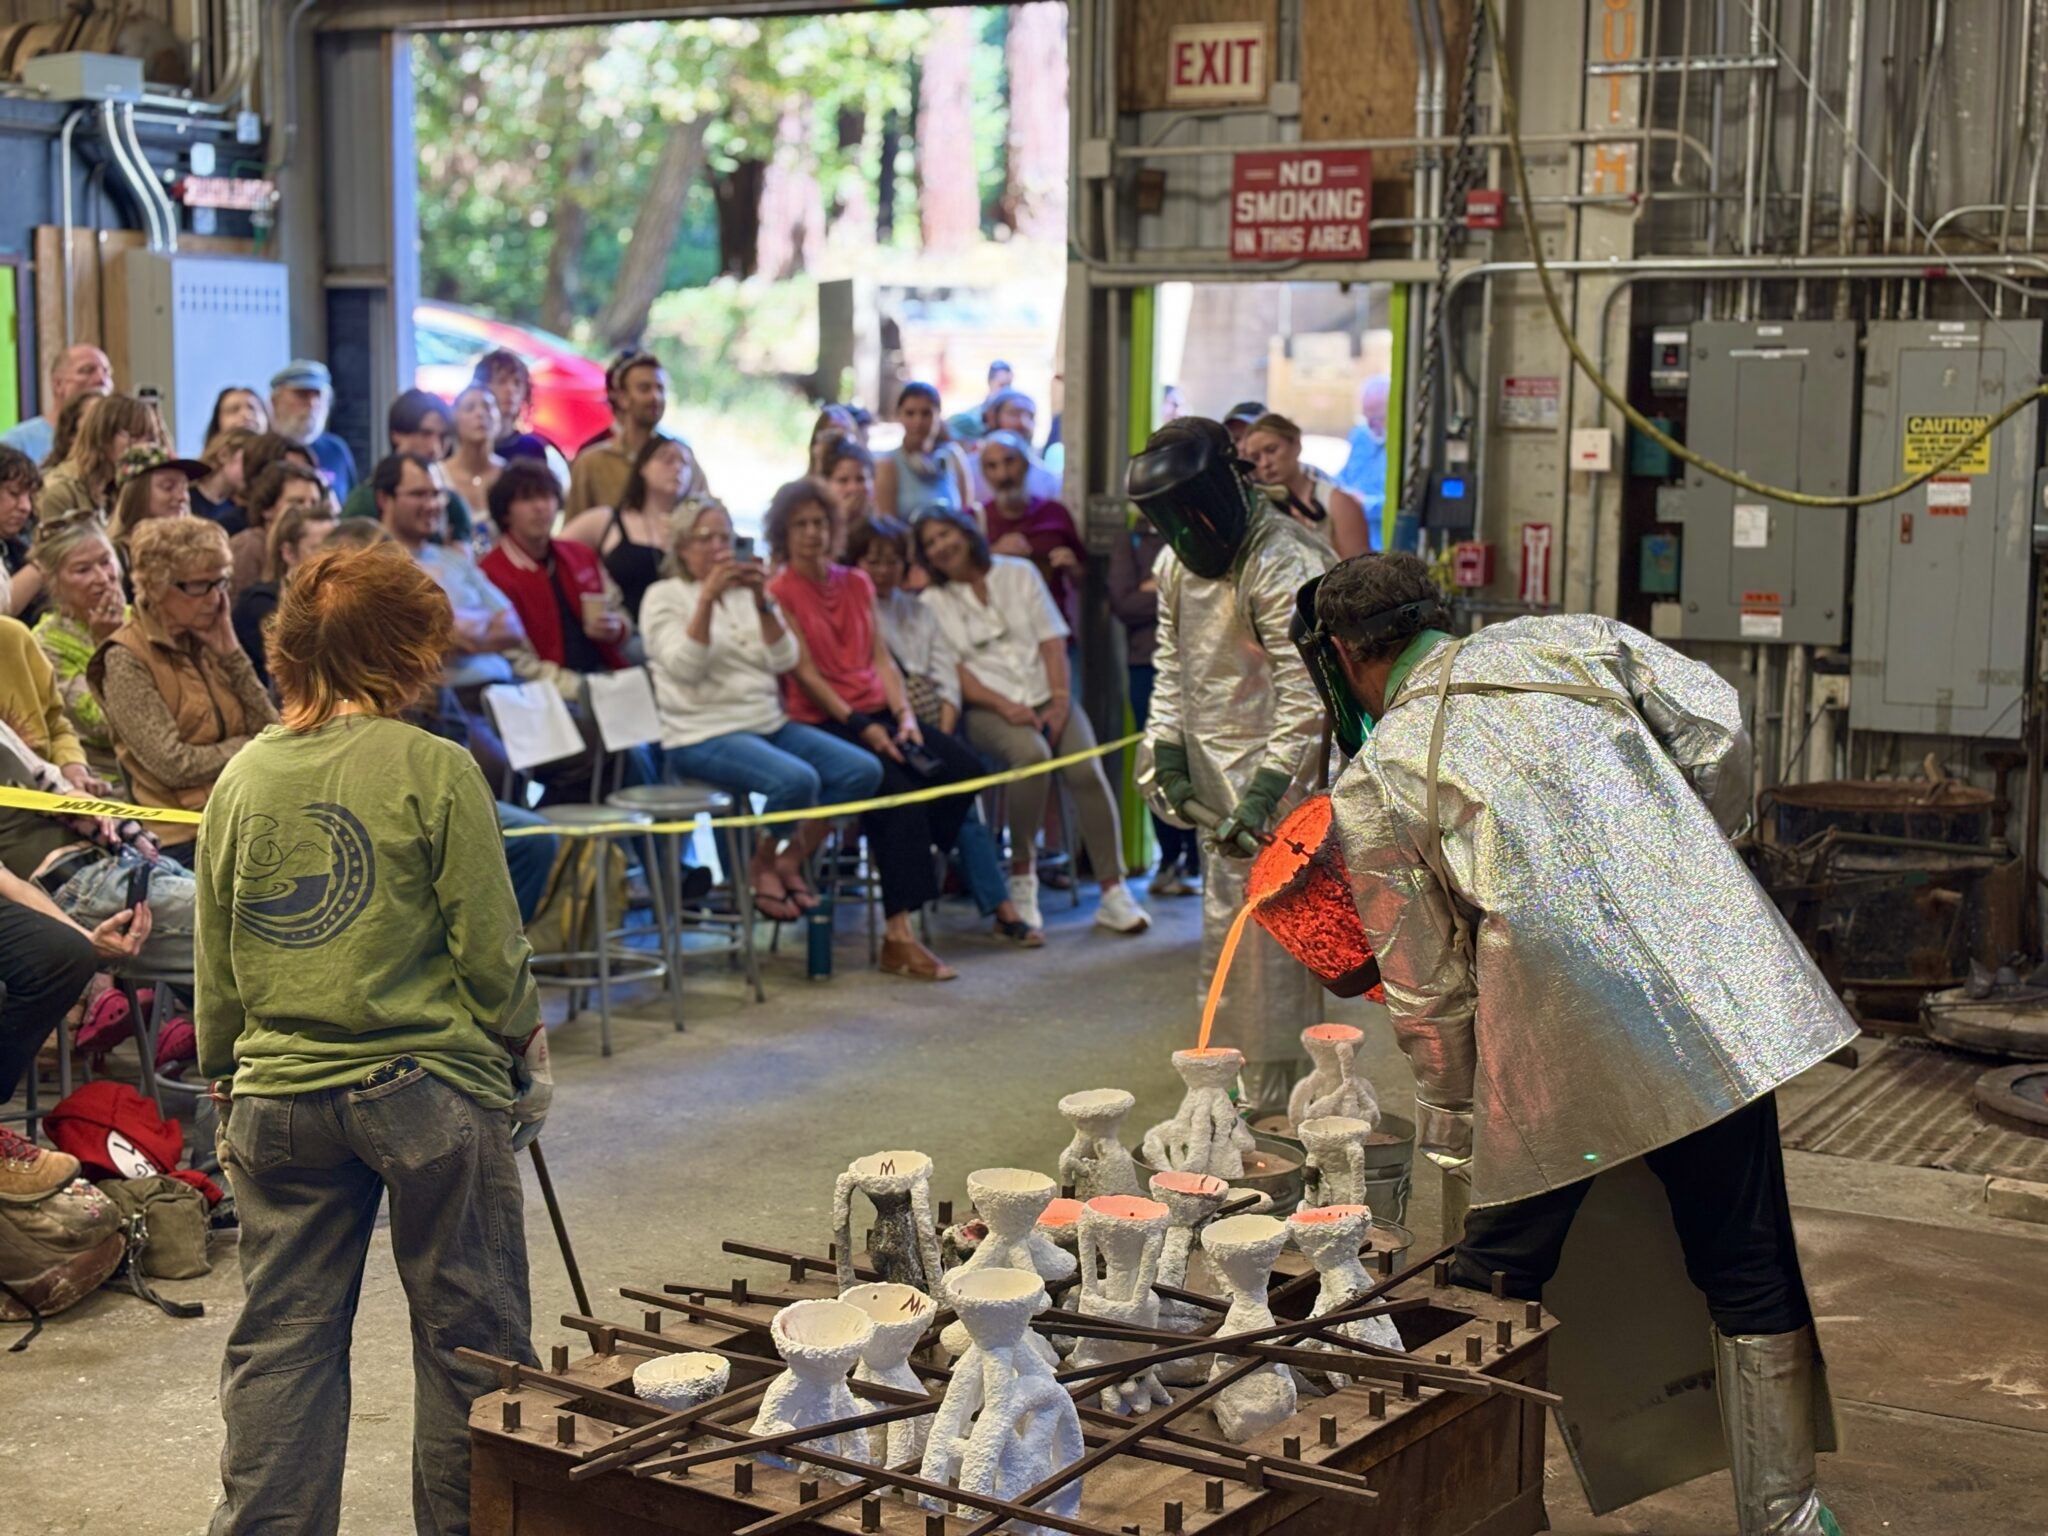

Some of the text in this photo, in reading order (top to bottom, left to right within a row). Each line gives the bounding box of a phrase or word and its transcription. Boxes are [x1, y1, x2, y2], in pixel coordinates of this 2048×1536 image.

[1175, 39, 1258, 86] EXIT
[1279, 159, 1323, 187] NO
[1236, 187, 1365, 223] SMOKING
[1235, 224, 1362, 254] IN THIS AREA
[880, 1159, 895, 1176] M
